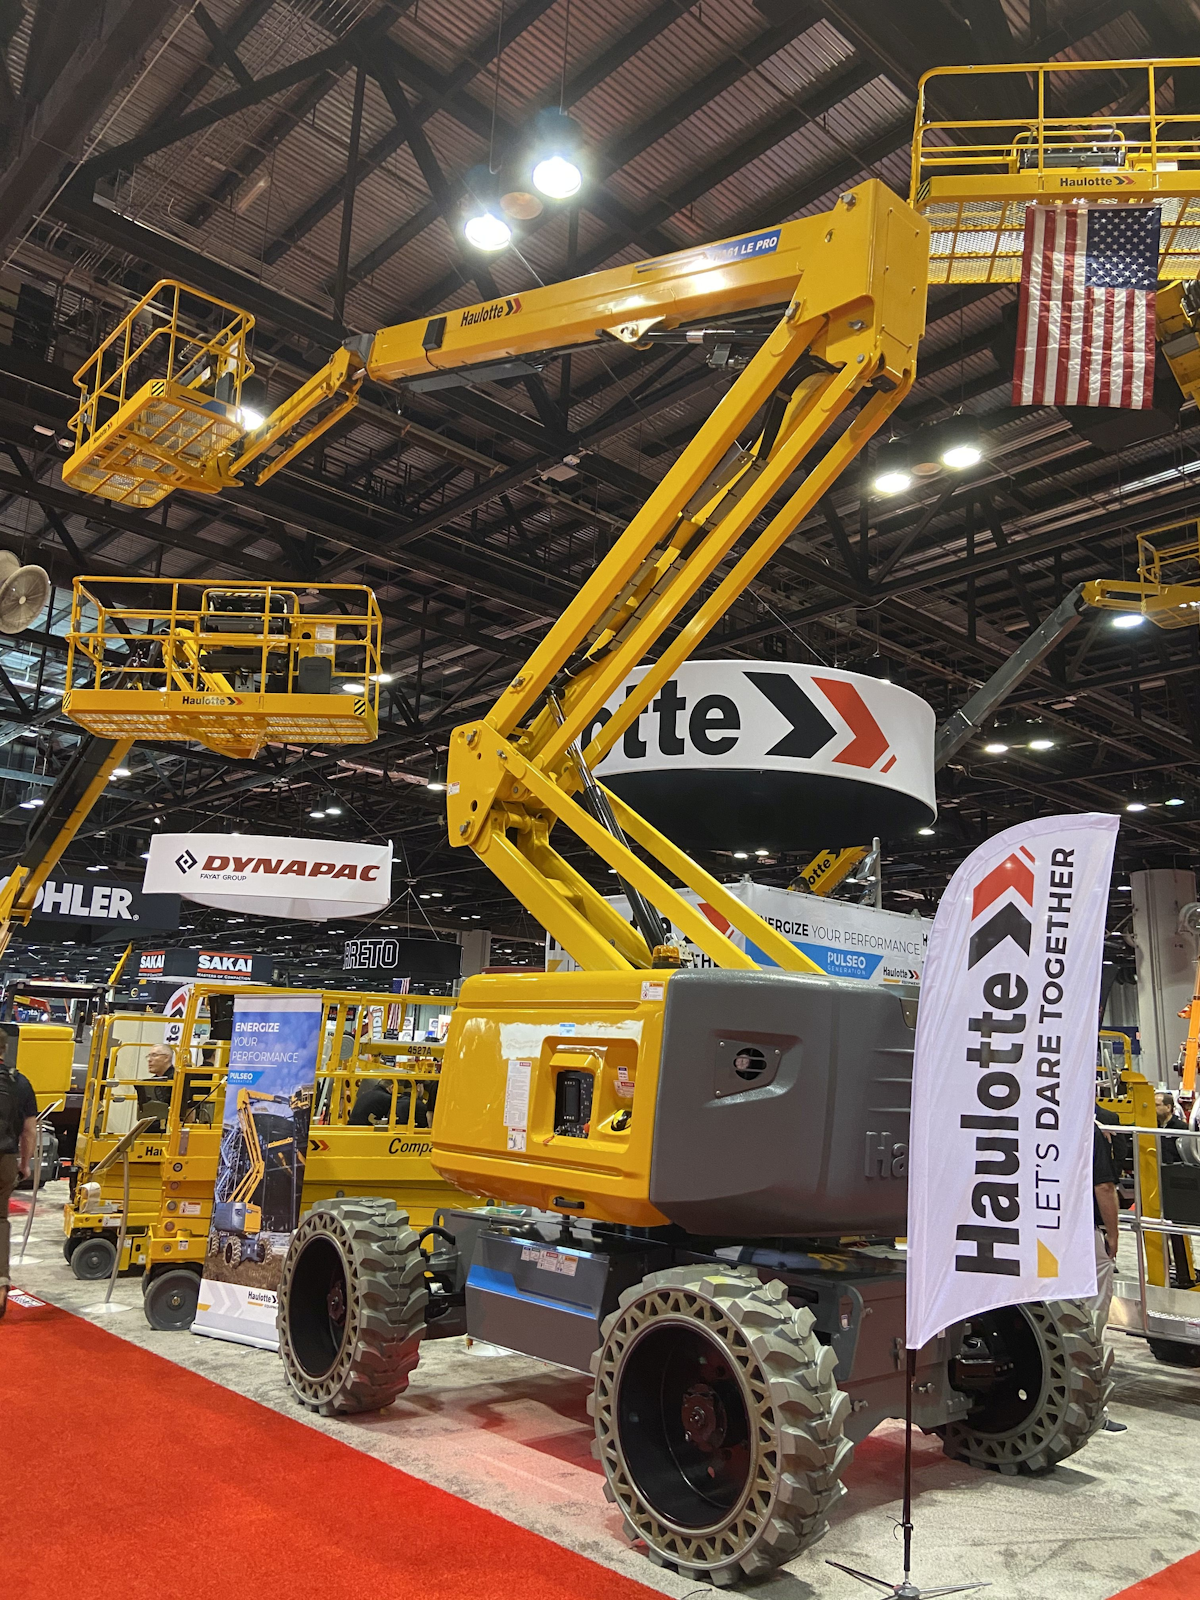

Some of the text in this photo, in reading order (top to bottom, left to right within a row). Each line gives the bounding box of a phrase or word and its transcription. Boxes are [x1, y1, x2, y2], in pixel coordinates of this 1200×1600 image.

[1060, 177, 1113, 187] Haulotte
[740, 242, 755, 255] LE
[755, 236, 778, 251] PRO
[460, 304, 504, 327] Haulotte
[182, 695, 226, 706] Haulotte
[201, 855, 381, 882] DYNAPAC
[0, 876, 134, 920] HLER
[811, 925, 841, 943] YOUR
[844, 931, 921, 956] PERFORMANCE
[140, 955, 165, 969] SAKAI
[198, 955, 252, 972] SAKAI
[827, 951, 866, 969] PULSEO
[827, 965, 866, 975] GENERATION
[883, 966, 908, 979] Haulotte
[235, 1022, 280, 1033] ENERGIZE
[234, 1037, 258, 1047] YOUR
[1035, 848, 1075, 1230] LET'S DARE TOGETHER
[232, 1051, 299, 1063] PERFORMANCE
[407, 1045, 432, 1056] 4527A
[230, 1072, 253, 1080] PULSEO
[955, 972, 1029, 1277] Haulotte
[248, 1291, 272, 1303] Haulotte
